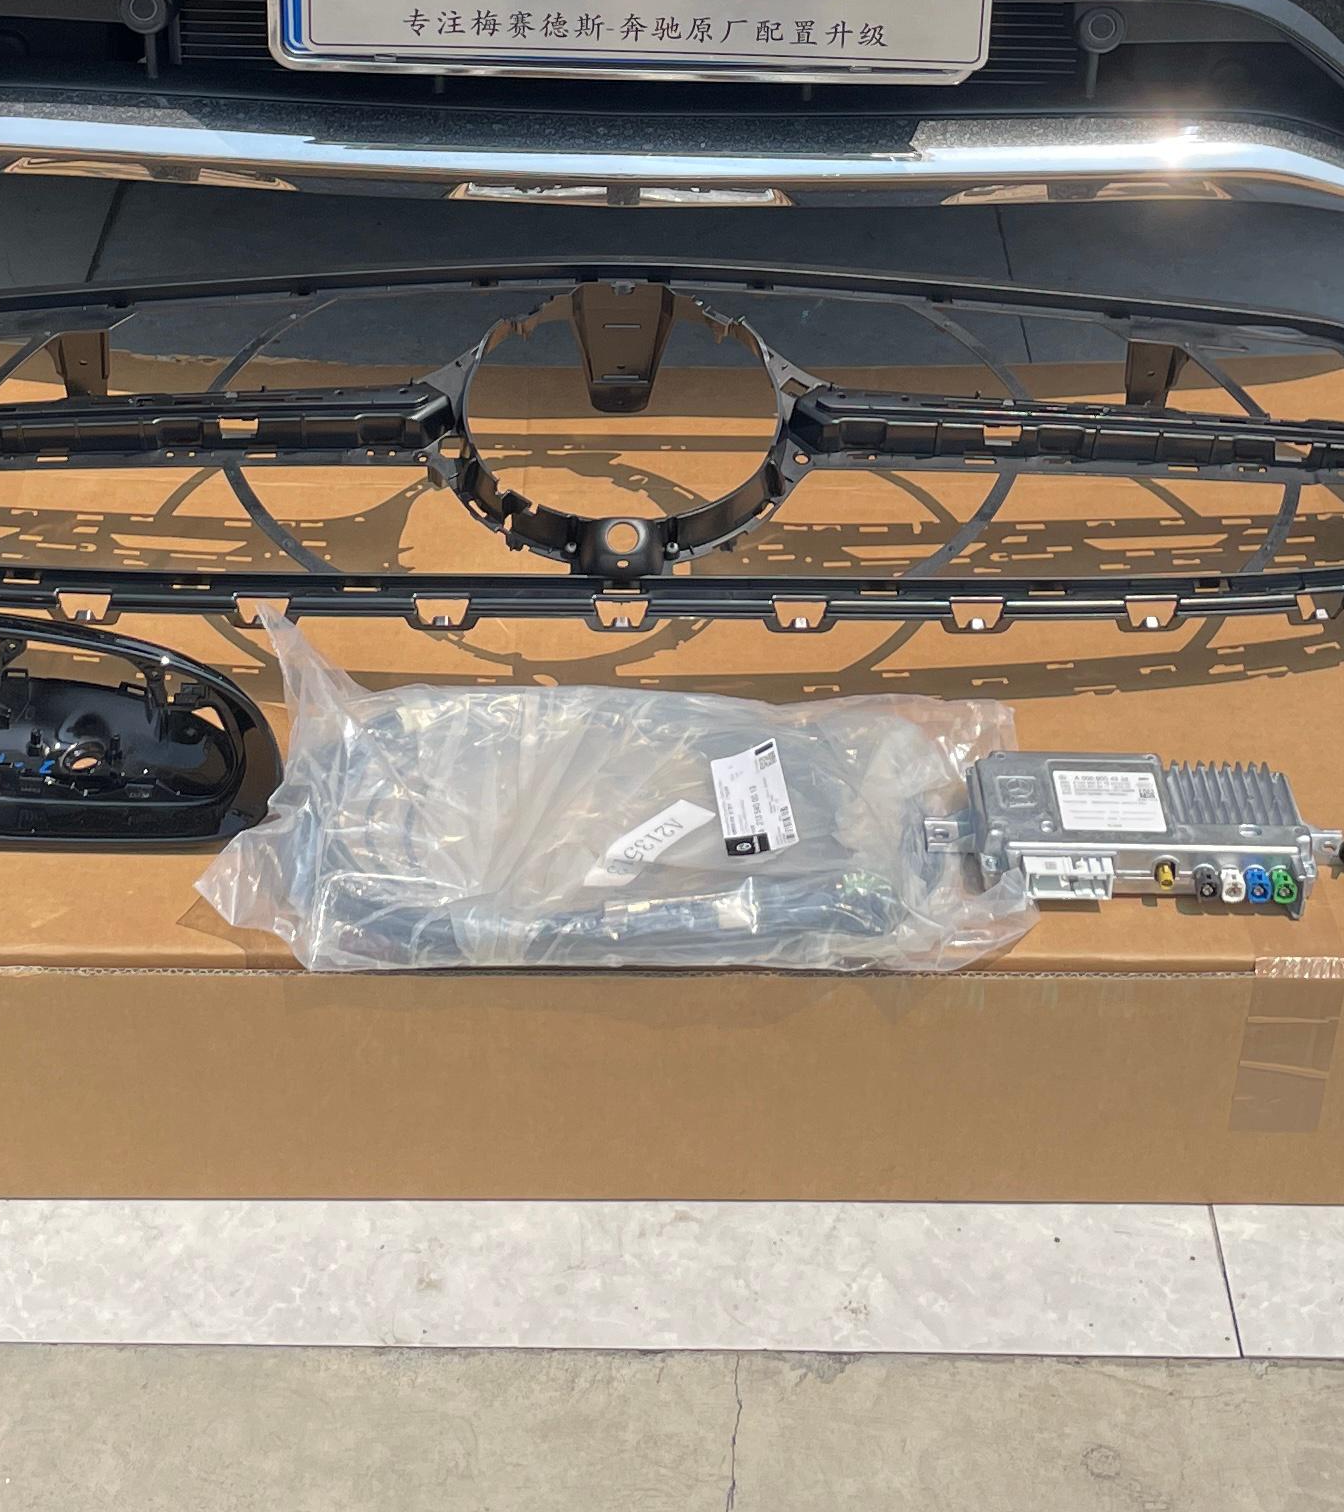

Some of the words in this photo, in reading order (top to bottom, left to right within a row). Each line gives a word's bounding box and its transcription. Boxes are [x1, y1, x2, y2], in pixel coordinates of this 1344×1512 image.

[403, 8, 889, 49] 专注梅赛德斯-奔驰原厂配置升级
